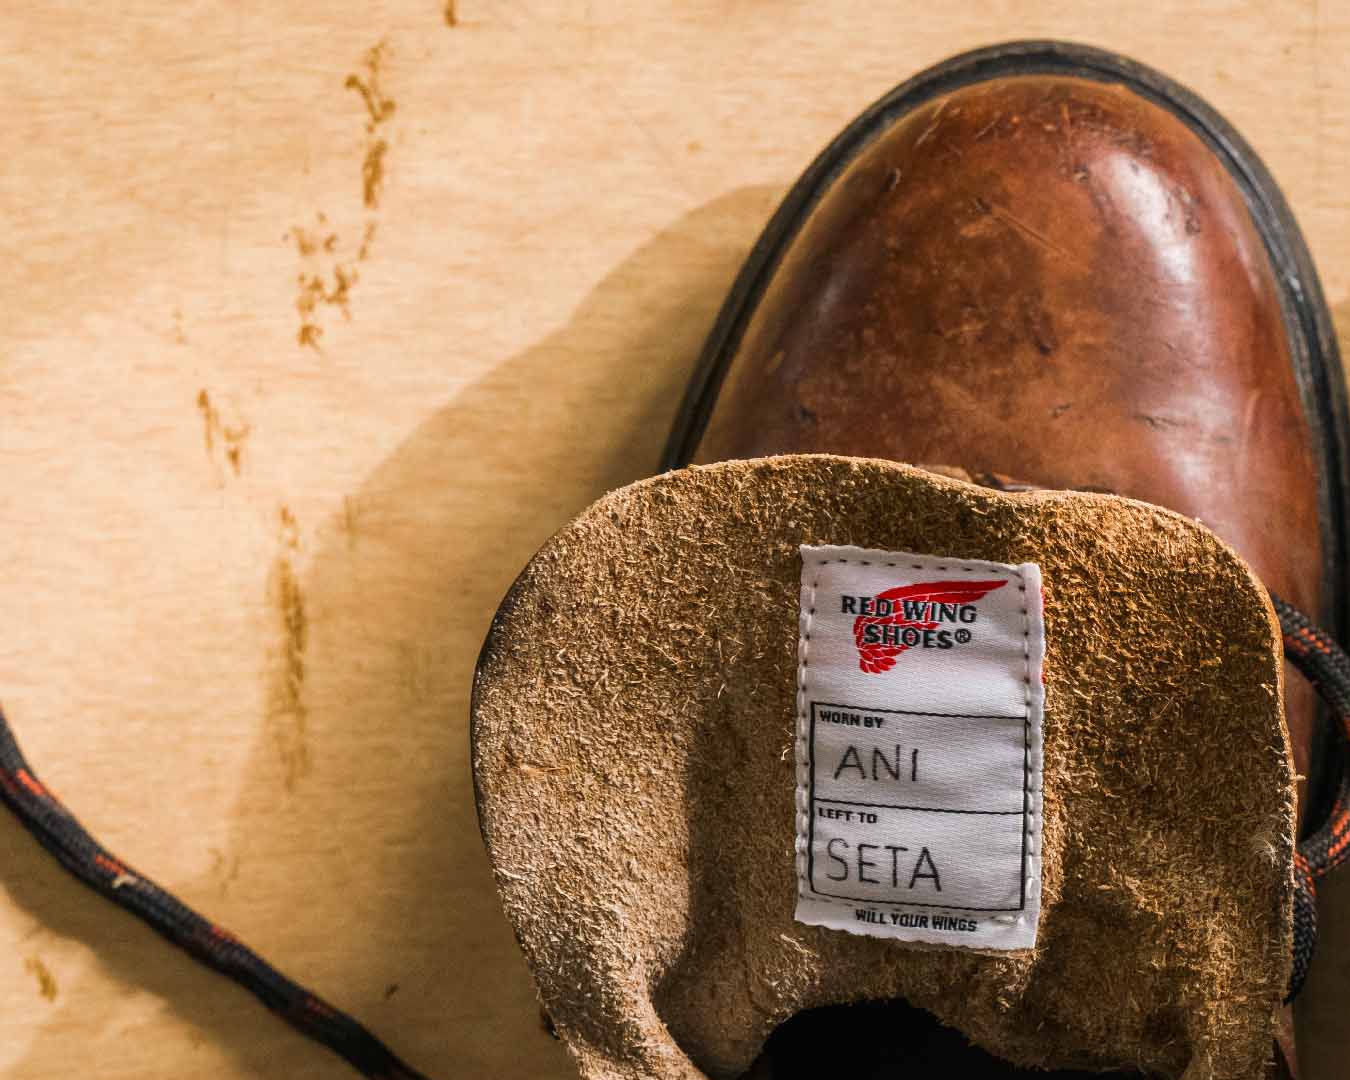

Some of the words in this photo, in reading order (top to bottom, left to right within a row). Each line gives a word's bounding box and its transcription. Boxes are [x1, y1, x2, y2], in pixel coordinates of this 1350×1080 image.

[841, 595, 894, 617] RED
[903, 600, 978, 624] WING
[820, 711, 860, 726] WORN
[863, 716, 884, 728] BY
[834, 744, 919, 782] ANI
[818, 807, 851, 820] LEFT
[859, 812, 878, 824] TO
[826, 838, 942, 892] SETA
[855, 909, 888, 924] WILL
[890, 913, 929, 928] YOUR
[932, 918, 978, 932] WINGS
